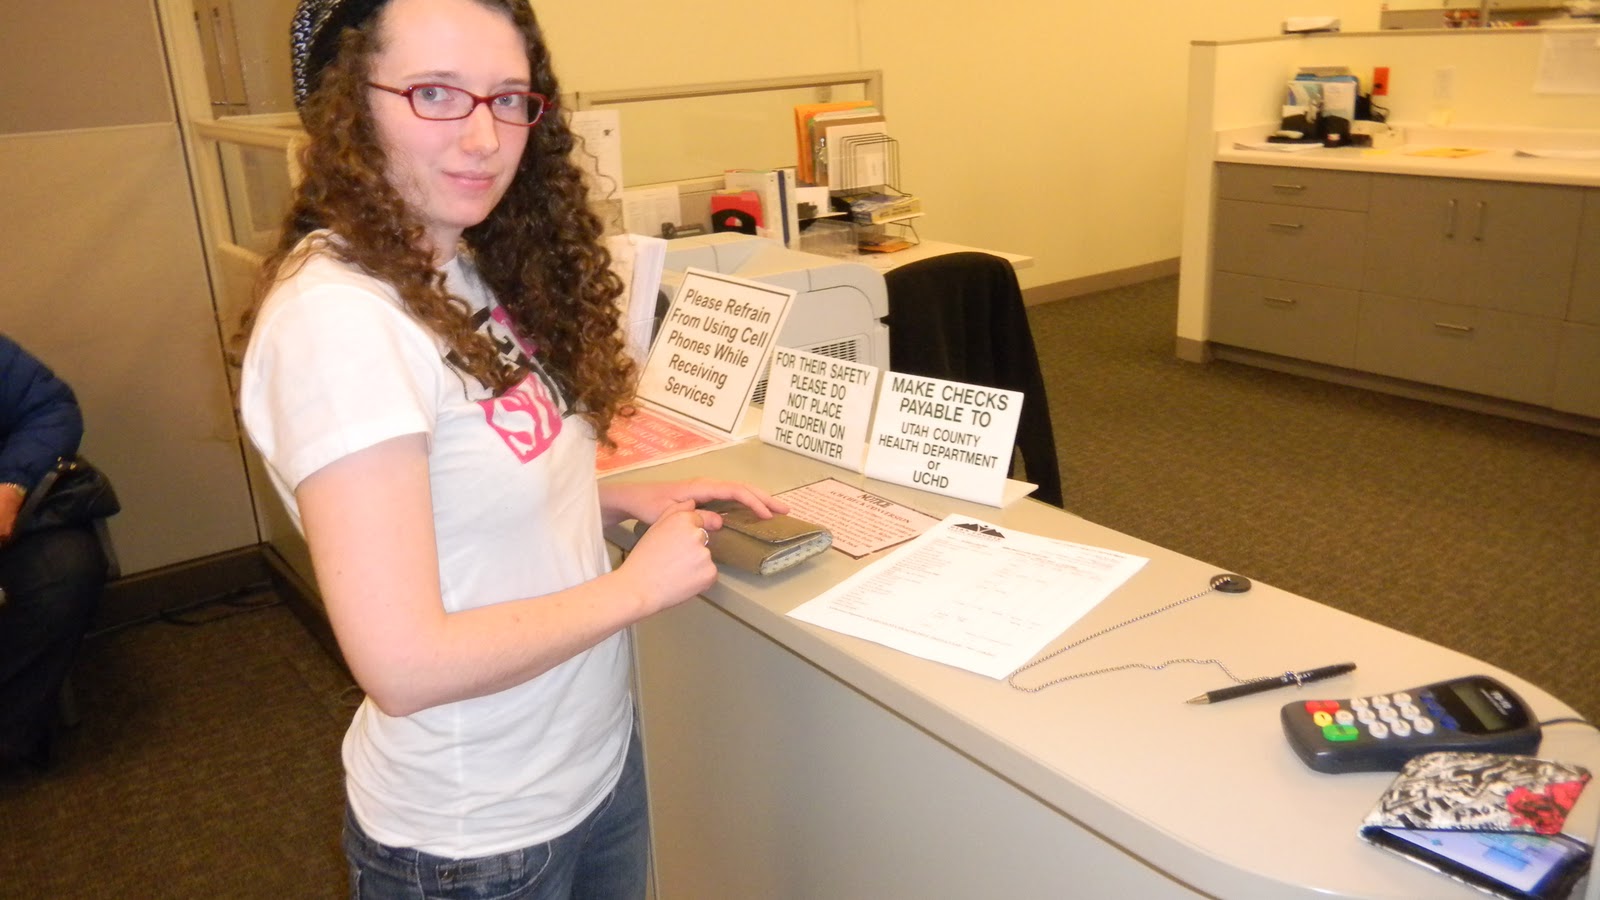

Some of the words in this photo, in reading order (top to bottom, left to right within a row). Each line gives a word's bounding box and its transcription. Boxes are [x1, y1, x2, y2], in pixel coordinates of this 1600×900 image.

[684, 288, 722, 311] Please
[724, 298, 771, 324] Refrain
[670, 308, 701, 328] From
[702, 316, 738, 343] Using
[741, 327, 768, 348] Cell
[668, 330, 711, 356] Phones
[714, 344, 749, 368] While
[668, 354, 728, 390] Receiving
[776, 352, 796, 368] FOR
[800, 357, 828, 376] THEIR
[830, 364, 870, 386] SAFETY
[664, 376, 716, 408] Services
[790, 374, 828, 396] PLEASE
[831, 384, 846, 400] DO
[892, 377, 936, 398] MAKE
[942, 386, 1009, 411] CHECKS
[787, 392, 808, 410] NOT
[810, 398, 843, 420] PLACE
[900, 398, 964, 423] PAYABLE
[971, 410, 992, 428] TO
[779, 409, 827, 435] CHILDREN
[830, 423, 846, 440] ON
[901, 422, 929, 438] UTAH
[933, 428, 981, 448] COUNTY
[775, 427, 793, 444] THE
[796, 433, 844, 460] COUNTER
[878, 434, 919, 452] HEALTH
[922, 443, 998, 469] DEPARTMENT
[913, 470, 949, 489] UCHD
[928, 460, 940, 470] or
